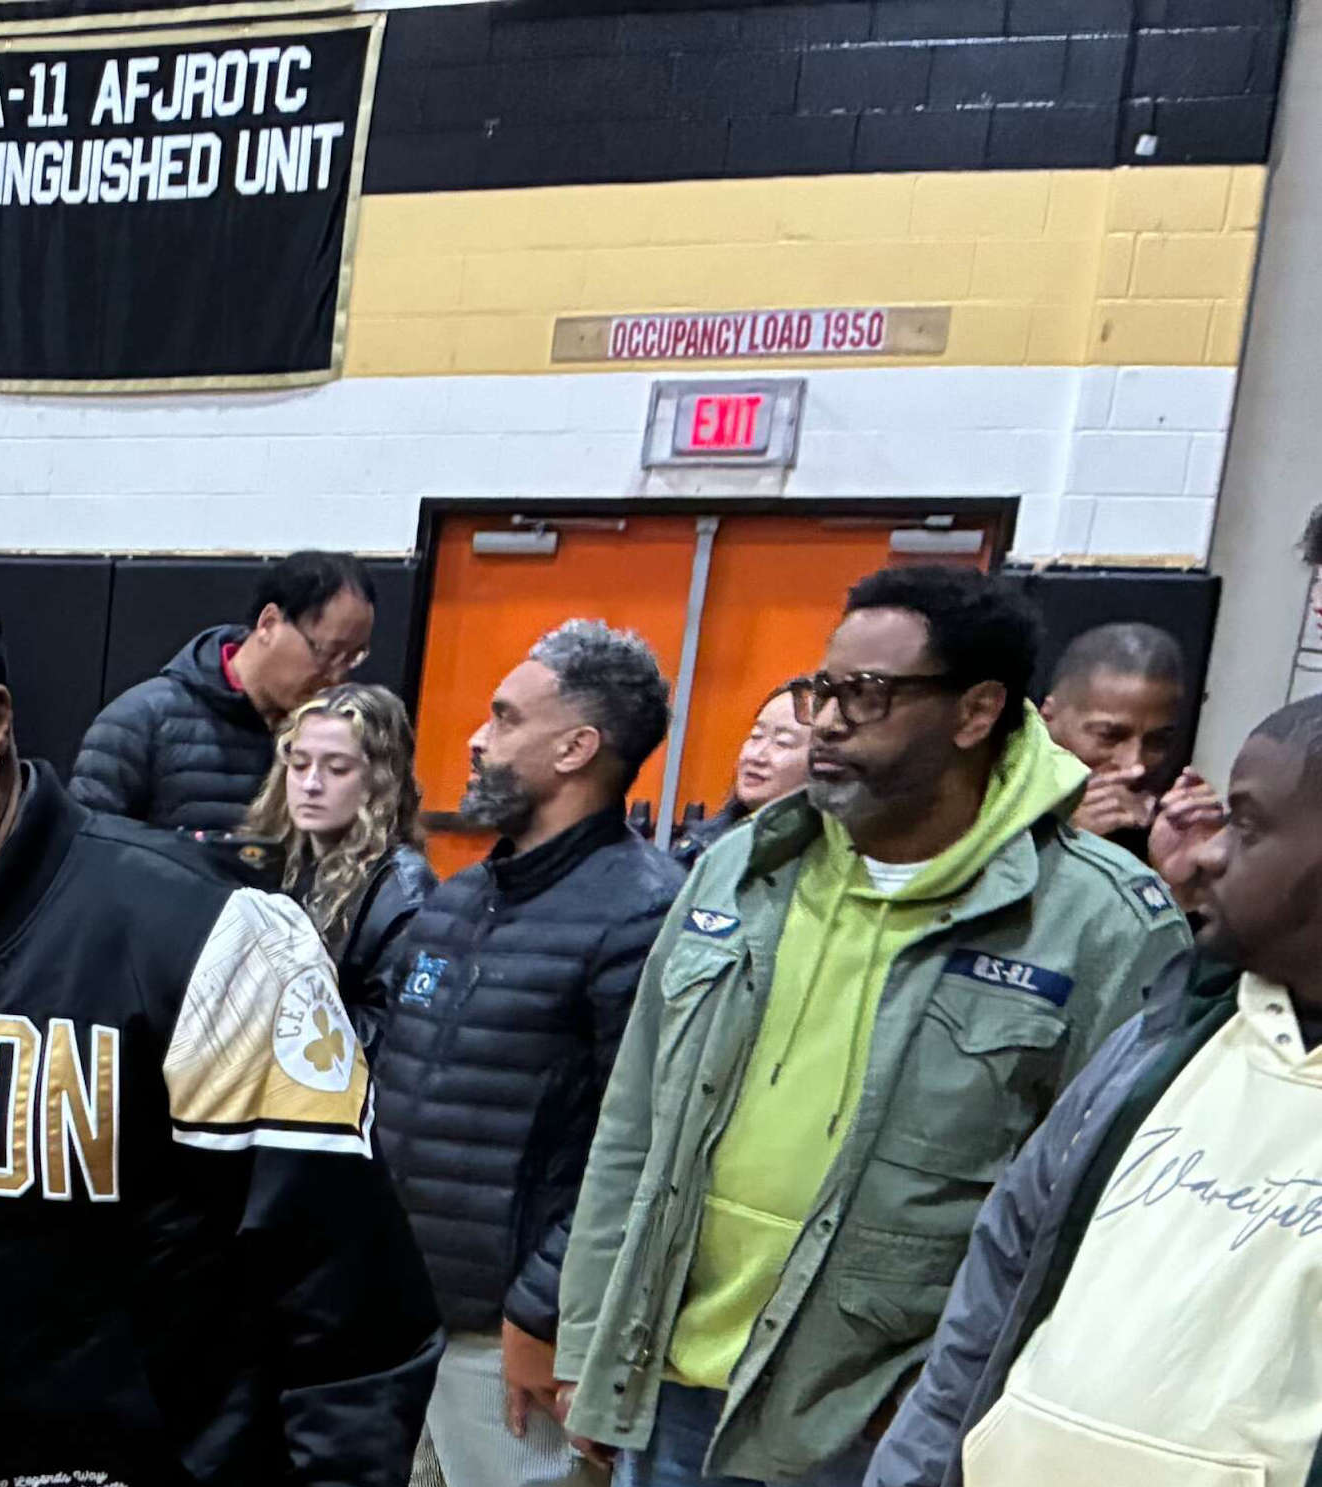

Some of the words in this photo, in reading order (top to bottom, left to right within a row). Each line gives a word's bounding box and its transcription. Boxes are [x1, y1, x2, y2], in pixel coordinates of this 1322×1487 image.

[91, 45, 311, 126] AFJROTC
[235, 121, 345, 196] UNIT
[612, 317, 743, 358] OCCUPANCY
[748, 313, 813, 351] LOAD
[822, 311, 884, 349] 1950
[689, 395, 764, 449] EXIT
[73, 1470, 108, 1484] Way
